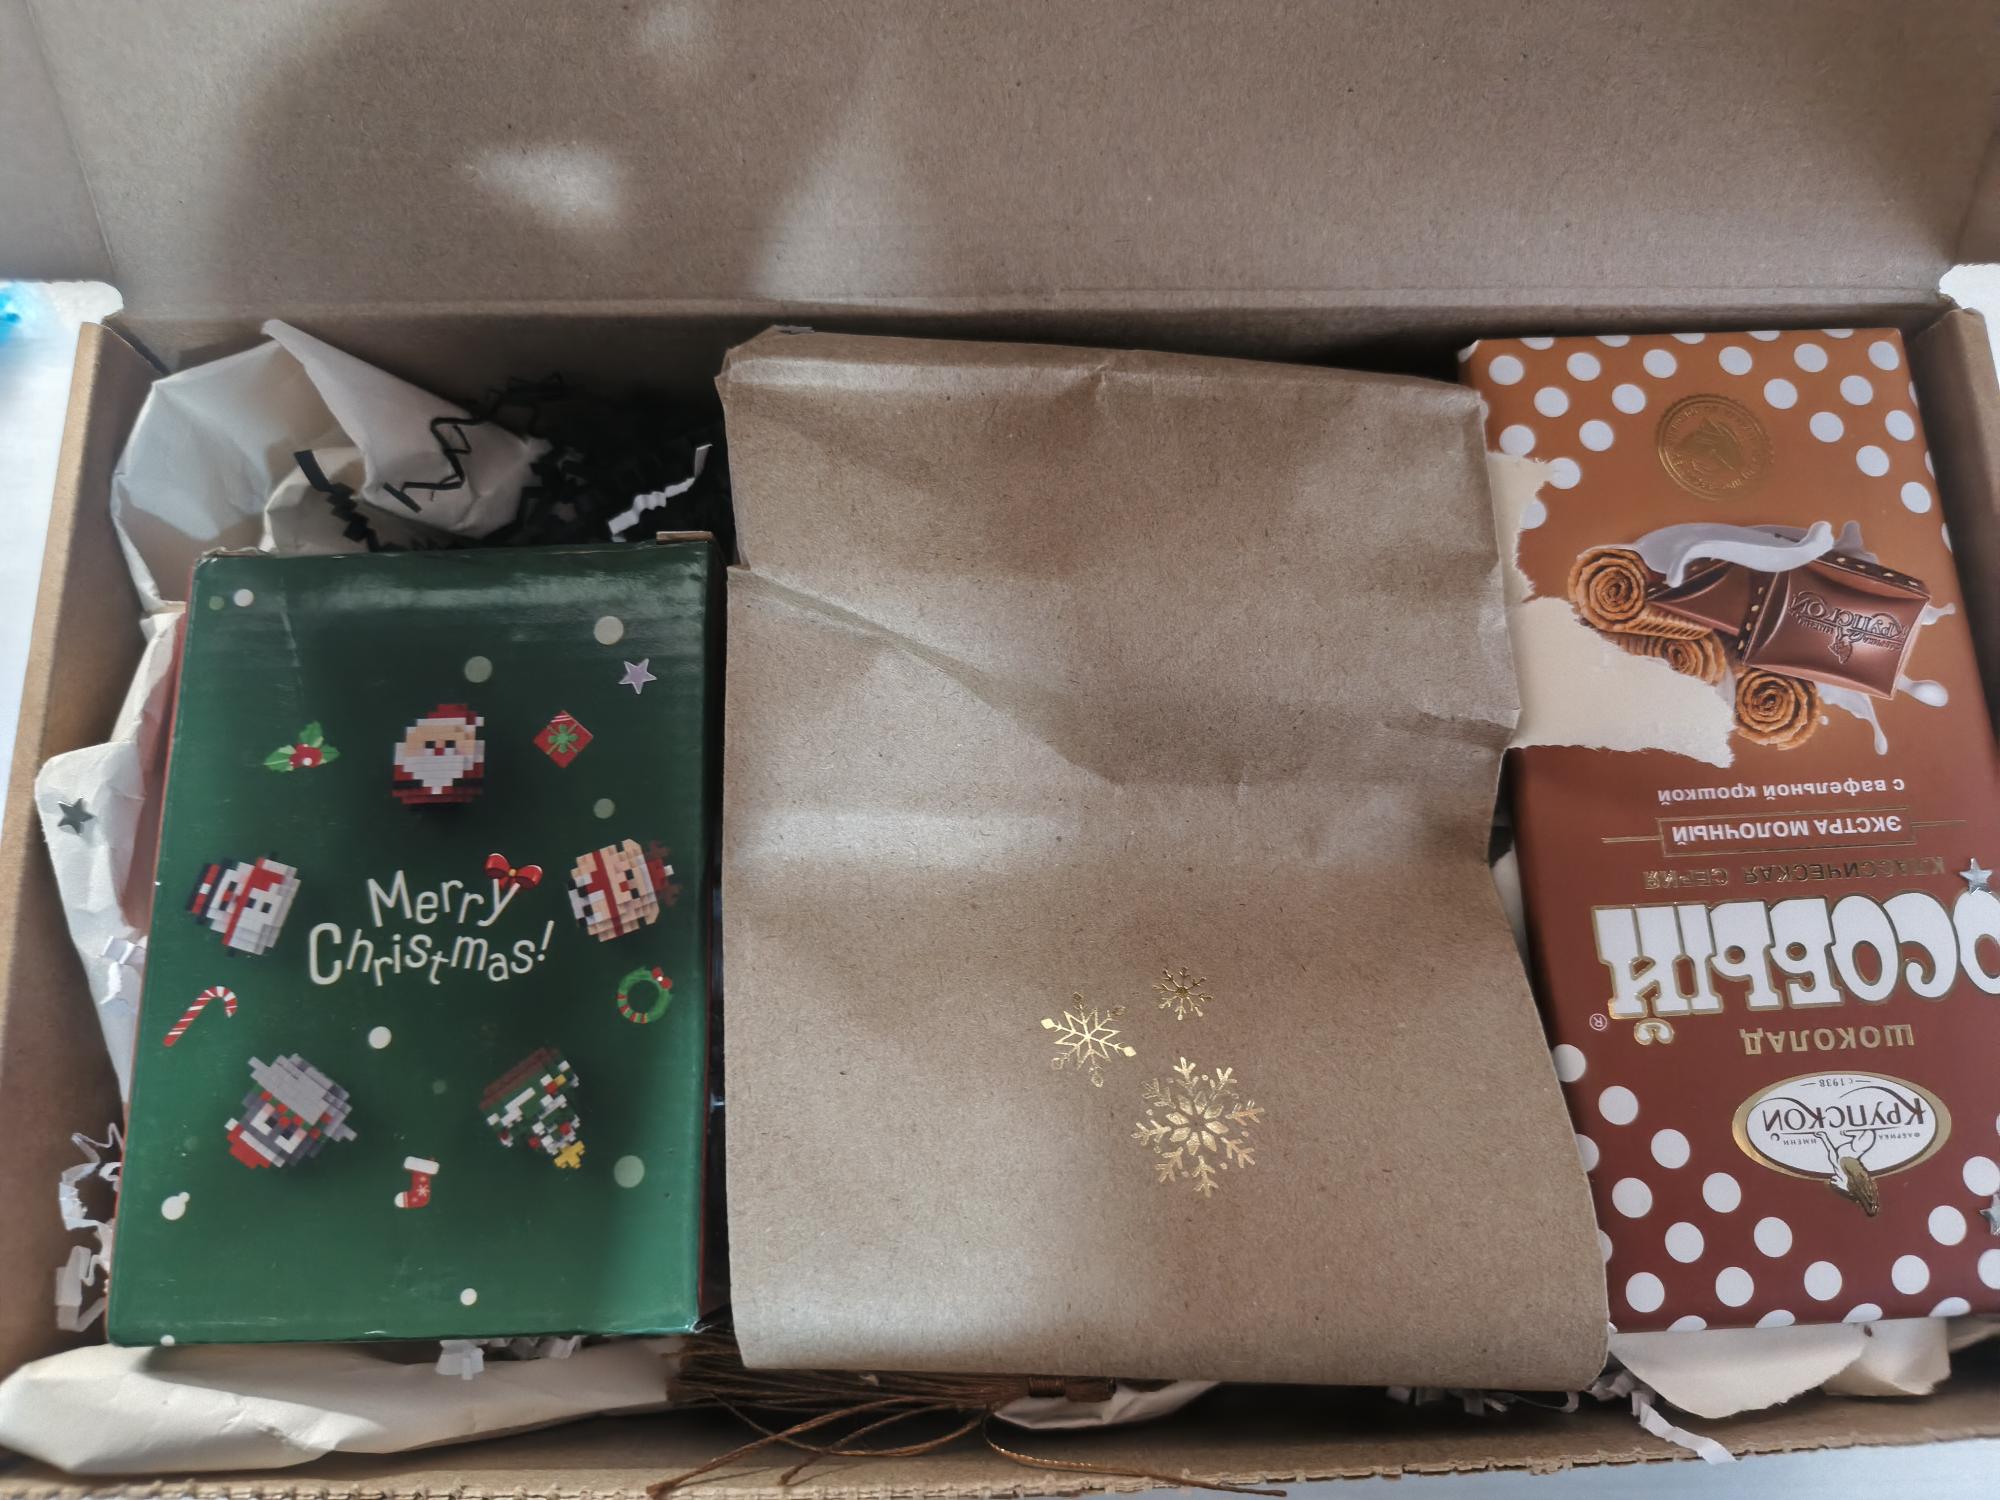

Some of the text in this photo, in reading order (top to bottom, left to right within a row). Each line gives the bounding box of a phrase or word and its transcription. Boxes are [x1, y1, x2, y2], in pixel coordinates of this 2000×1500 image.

[1657, 777, 1905, 806] с вафельной крошкой
[1670, 815, 1902, 845] ЭКСТРА МОЛОЧНЫЙ
[1642, 856, 1946, 890] КЛАССИЧЕСКАЯ СЕРИЯ
[367, 870, 520, 928] Merry
[309, 921, 555, 987] Christmas!
[1591, 890, 2000, 1046] ОСОБЫЙ
[1738, 1023, 1915, 1055] ШОКОЛАД
[1818, 1077, 1846, 1087] 1938
[1755, 1087, 1926, 1141] КРУПСКОЙ
[1782, 1137, 1817, 1146] ИМЕНИ
